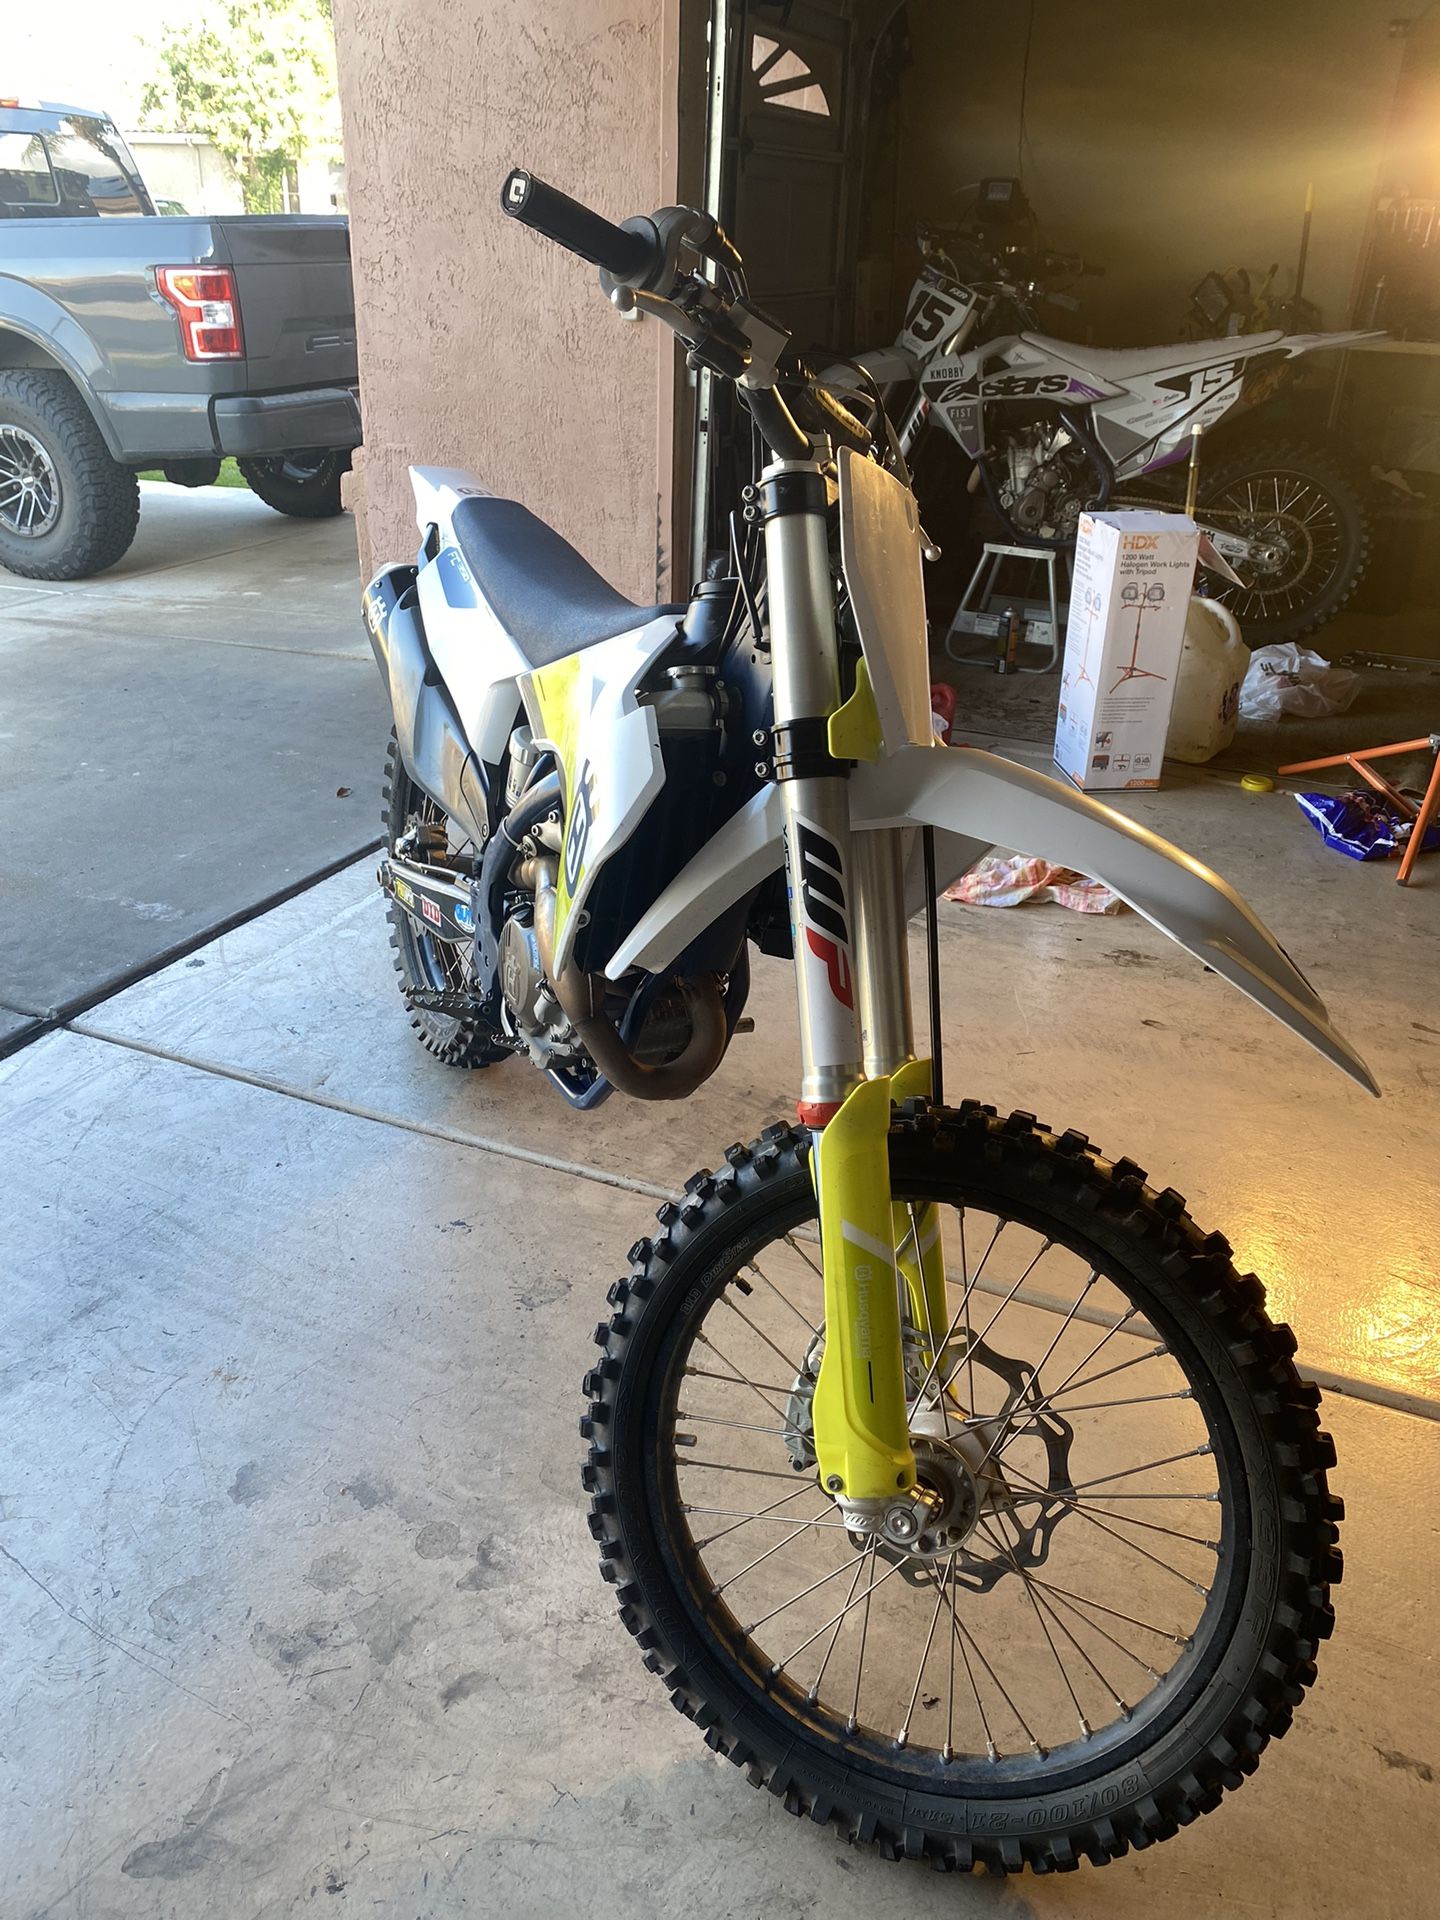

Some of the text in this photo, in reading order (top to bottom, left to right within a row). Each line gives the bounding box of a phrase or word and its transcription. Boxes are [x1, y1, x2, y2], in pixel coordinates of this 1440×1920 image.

[905, 290, 956, 342] 15
[930, 366, 965, 379] KNOBBY
[1188, 361, 1236, 401] 15
[950, 408, 972, 418] FIST
[1122, 535, 1160, 550] HDX
[1120, 561, 1149, 569] Halogen
[856, 1282, 872, 1359] Husqvarna
[969, 1772, 1140, 1830] 80/100-21
